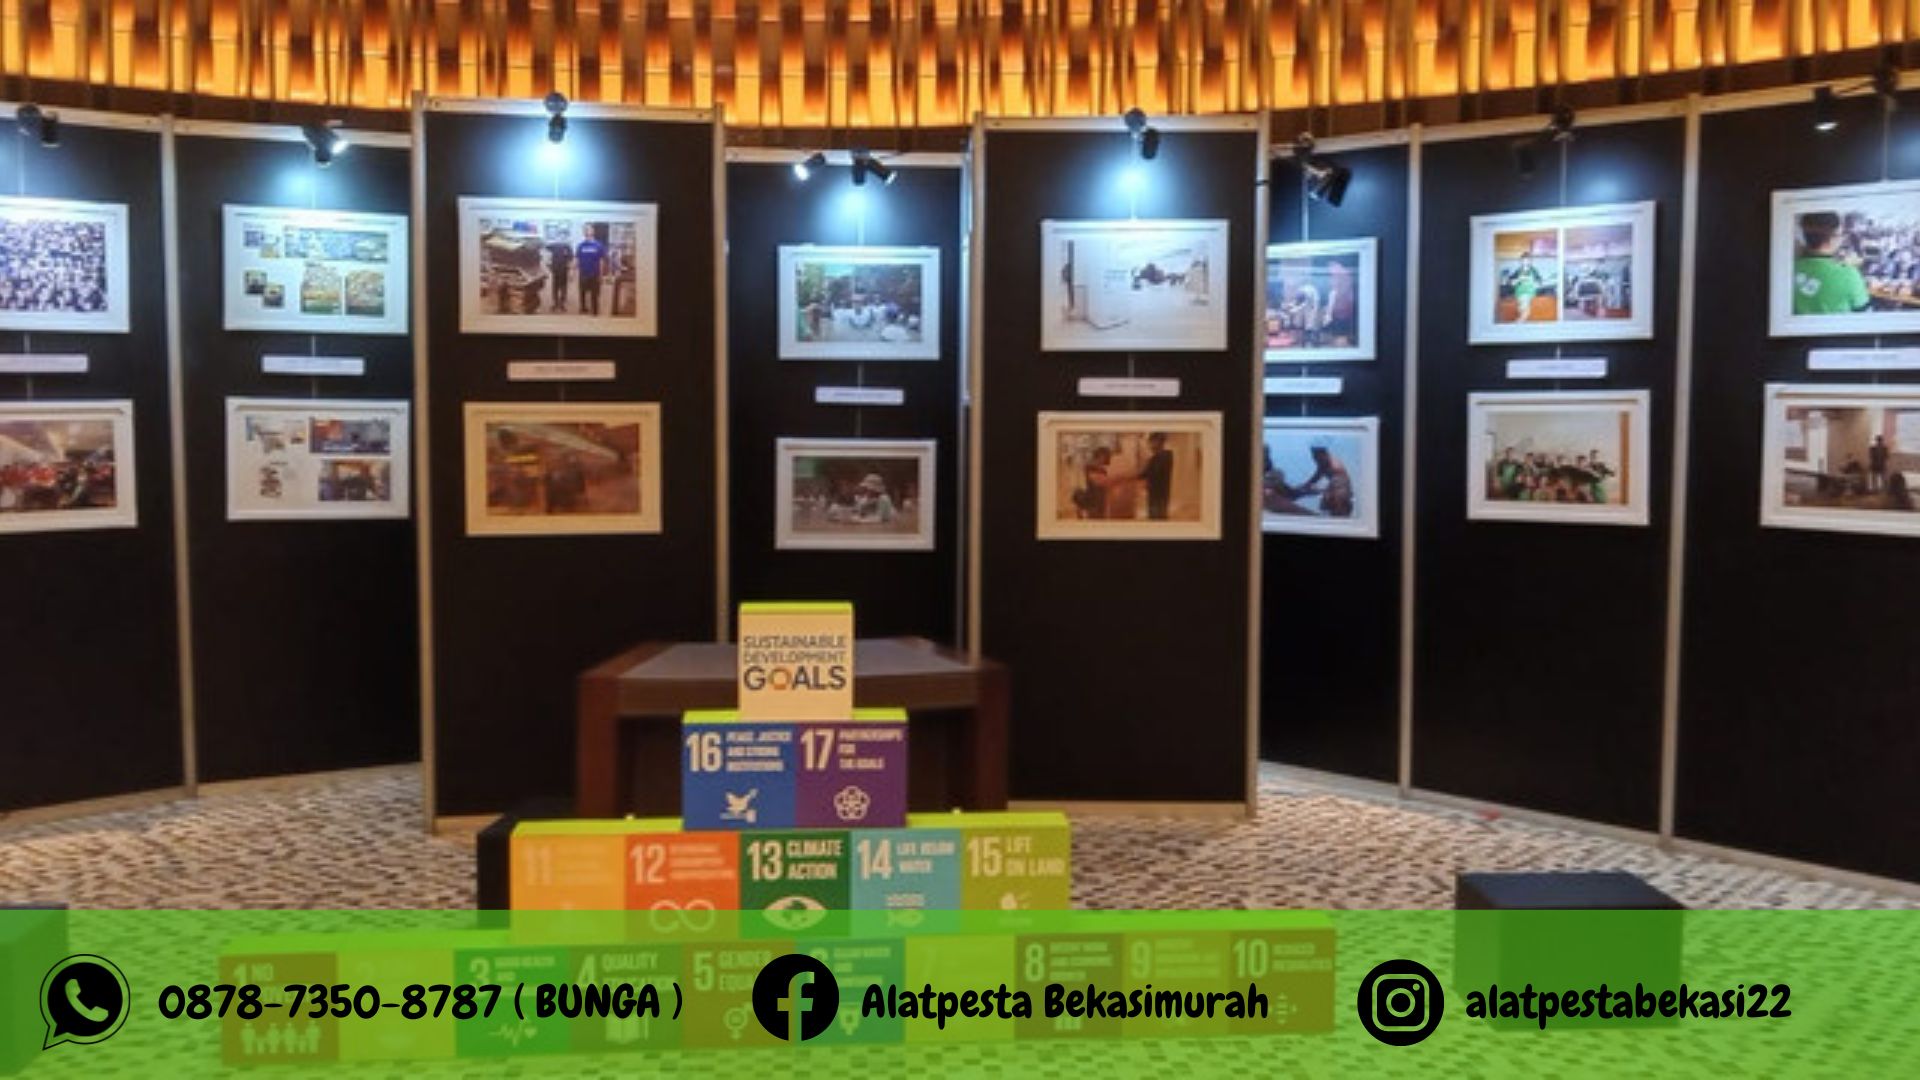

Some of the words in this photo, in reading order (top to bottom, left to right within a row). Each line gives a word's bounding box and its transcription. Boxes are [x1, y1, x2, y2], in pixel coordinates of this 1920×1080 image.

[743, 635, 845, 649] SUSTAINABLE
[743, 651, 845, 663] DEVELOPMENT
[743, 665, 847, 691] GOALS
[686, 731, 722, 772] 16
[800, 728, 835, 770] 17
[629, 844, 667, 885] 12
[747, 840, 784, 881] 13
[786, 838, 843, 857] CLIMATE
[857, 839, 893, 880] 14
[967, 836, 1003, 877] 15
[788, 862, 839, 880] ACTION
[602, 953, 660, 972] QUALITY
[693, 951, 715, 991] 5
[1025, 942, 1045, 982] 8
[1130, 940, 1150, 980] 9
[1232, 938, 1269, 979] 10
